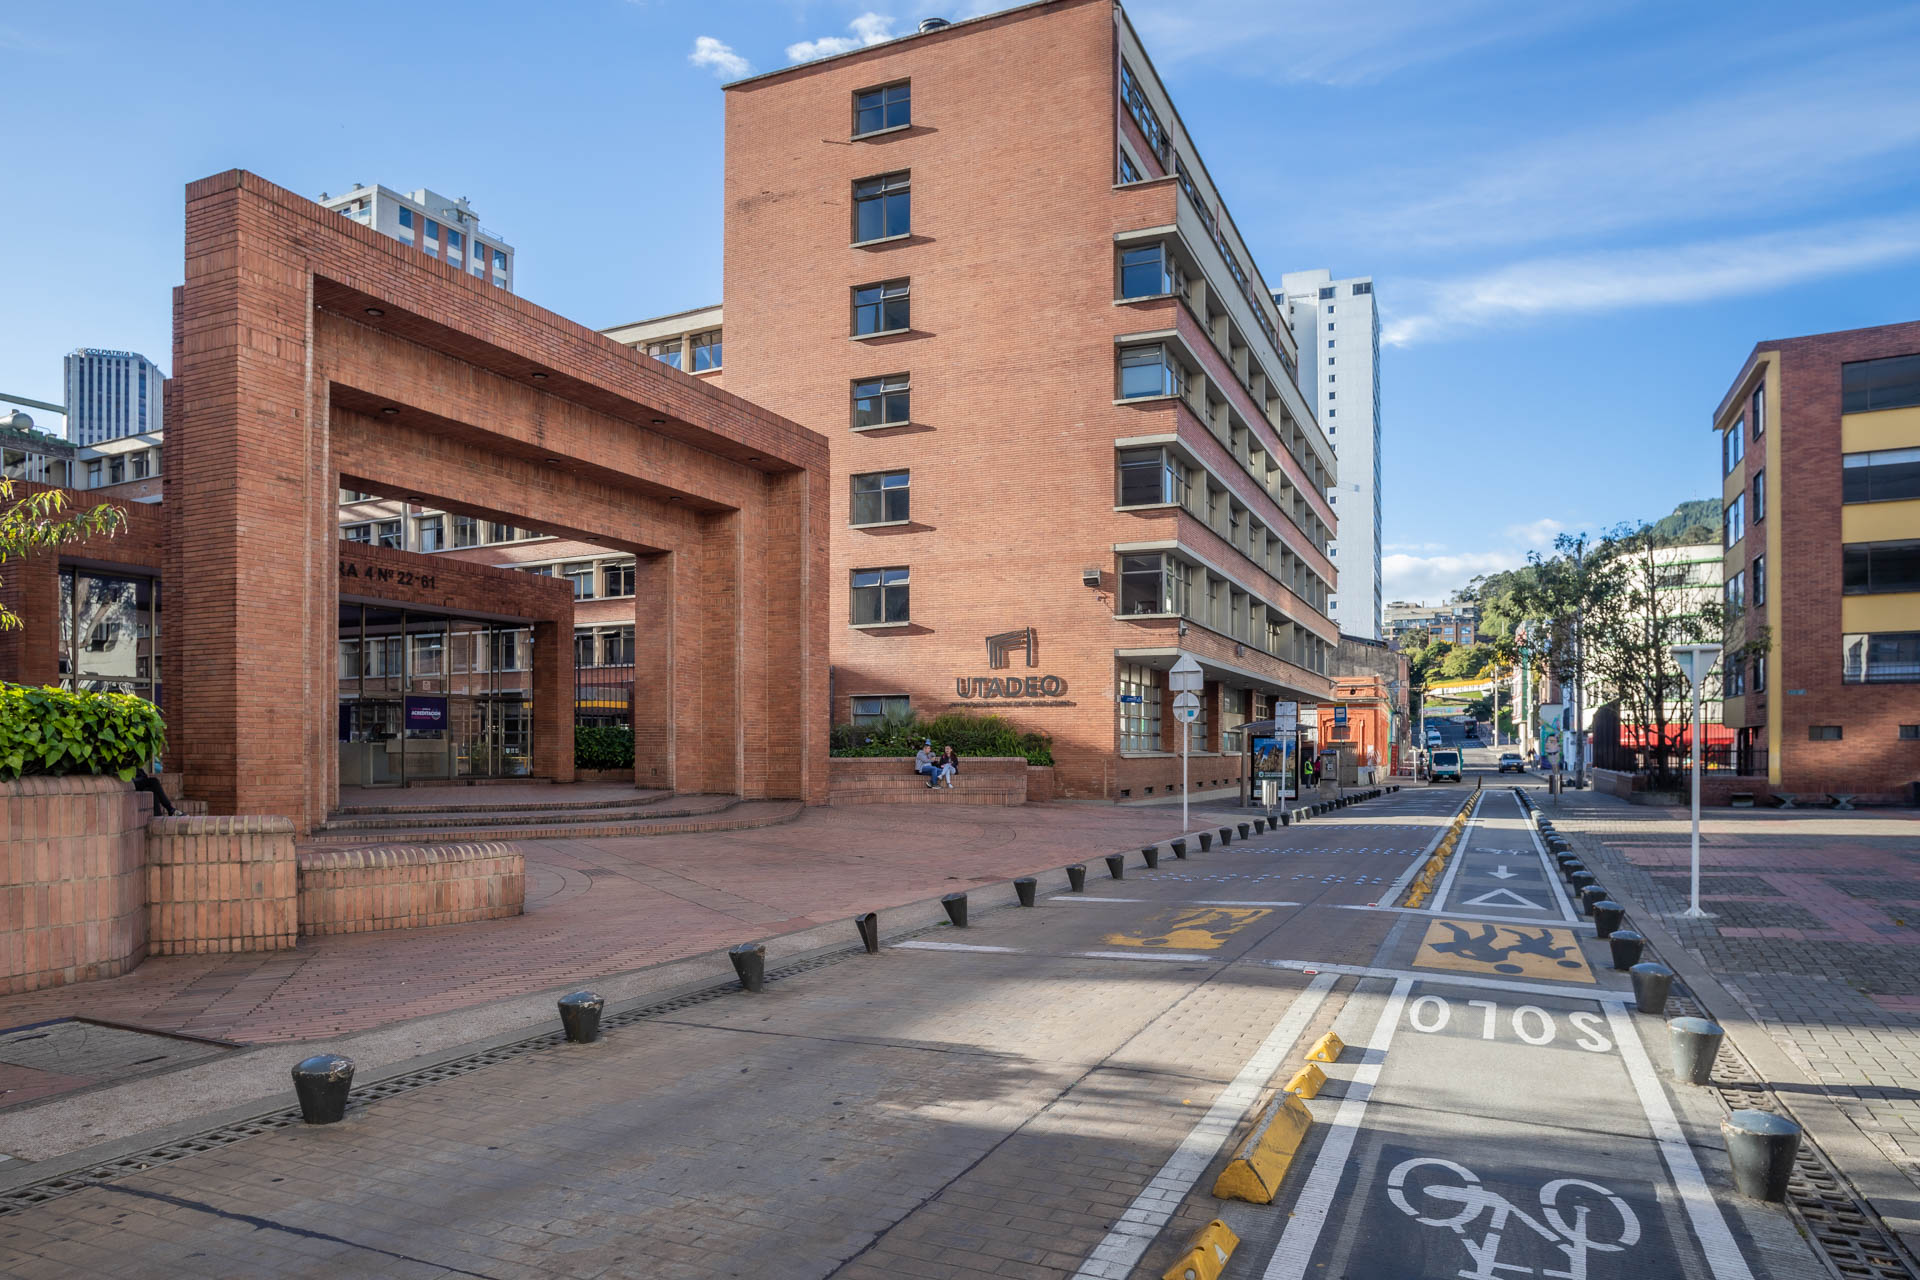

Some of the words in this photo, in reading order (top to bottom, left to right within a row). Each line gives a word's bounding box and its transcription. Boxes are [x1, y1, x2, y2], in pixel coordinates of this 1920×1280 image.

[85, 348, 130, 357] COLPATRIA
[365, 566, 374, 581] 4
[397, 571, 435, 589] 22-61
[956, 675, 1061, 699] UTADEO
[1409, 995, 1612, 1053] SOLO
